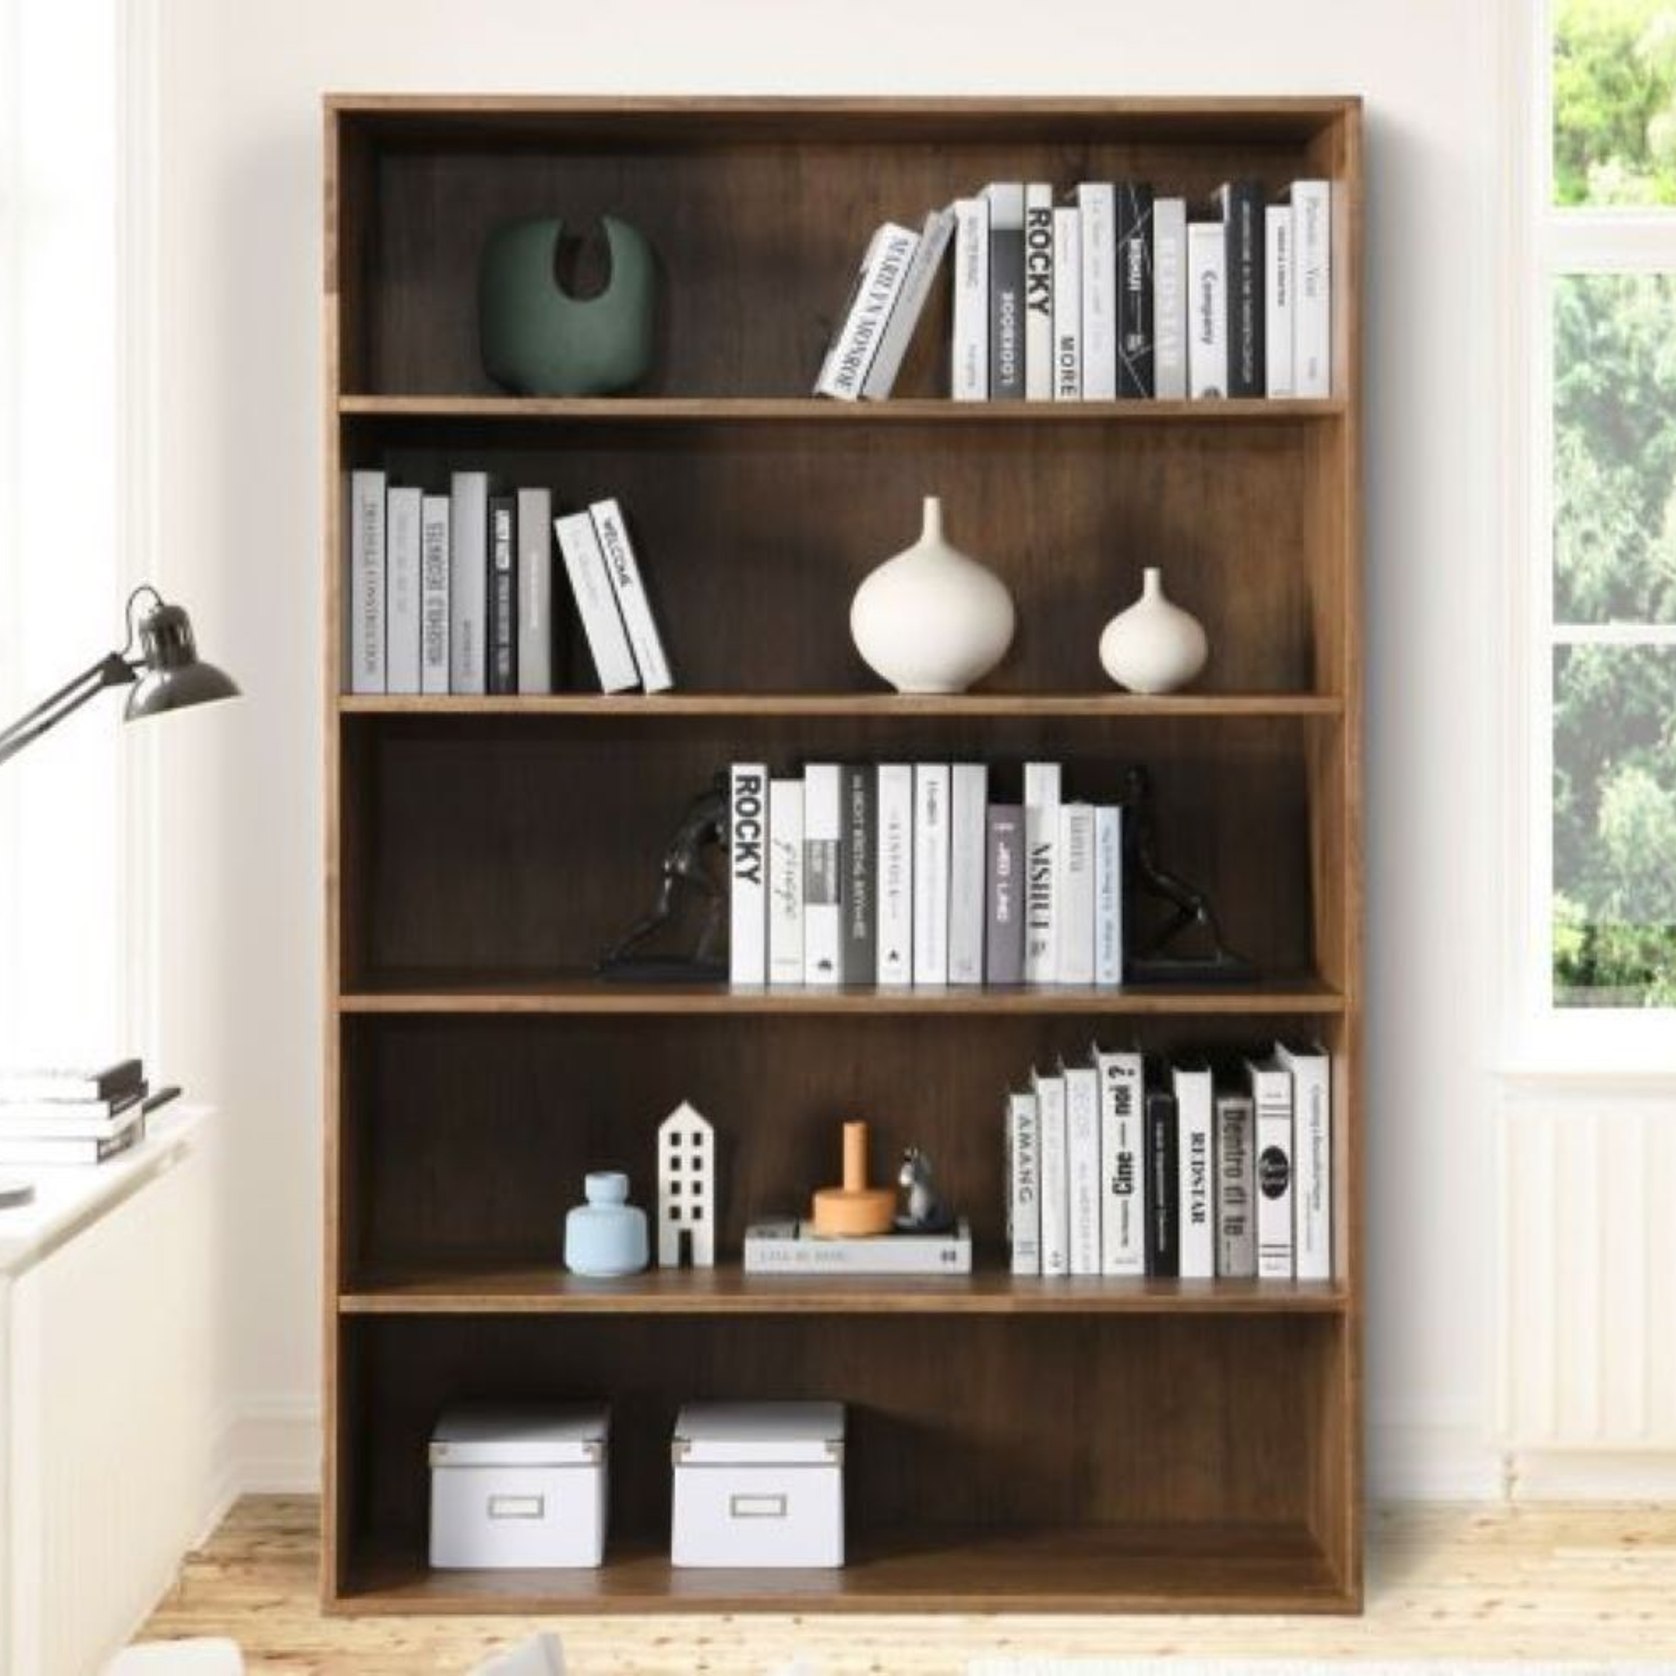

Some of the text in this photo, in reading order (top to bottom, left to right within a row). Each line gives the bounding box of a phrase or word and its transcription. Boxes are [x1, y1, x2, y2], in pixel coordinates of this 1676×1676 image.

[1028, 206, 1050, 317] ROCKY
[1201, 269, 1218, 345] Company
[1060, 335, 1076, 397] MORE
[604, 516, 633, 588] WELCOME
[735, 774, 762, 885] ROCKY
[1112, 1151, 1134, 1196] Cine
[1191, 1132, 1205, 1224] REDSTAR
